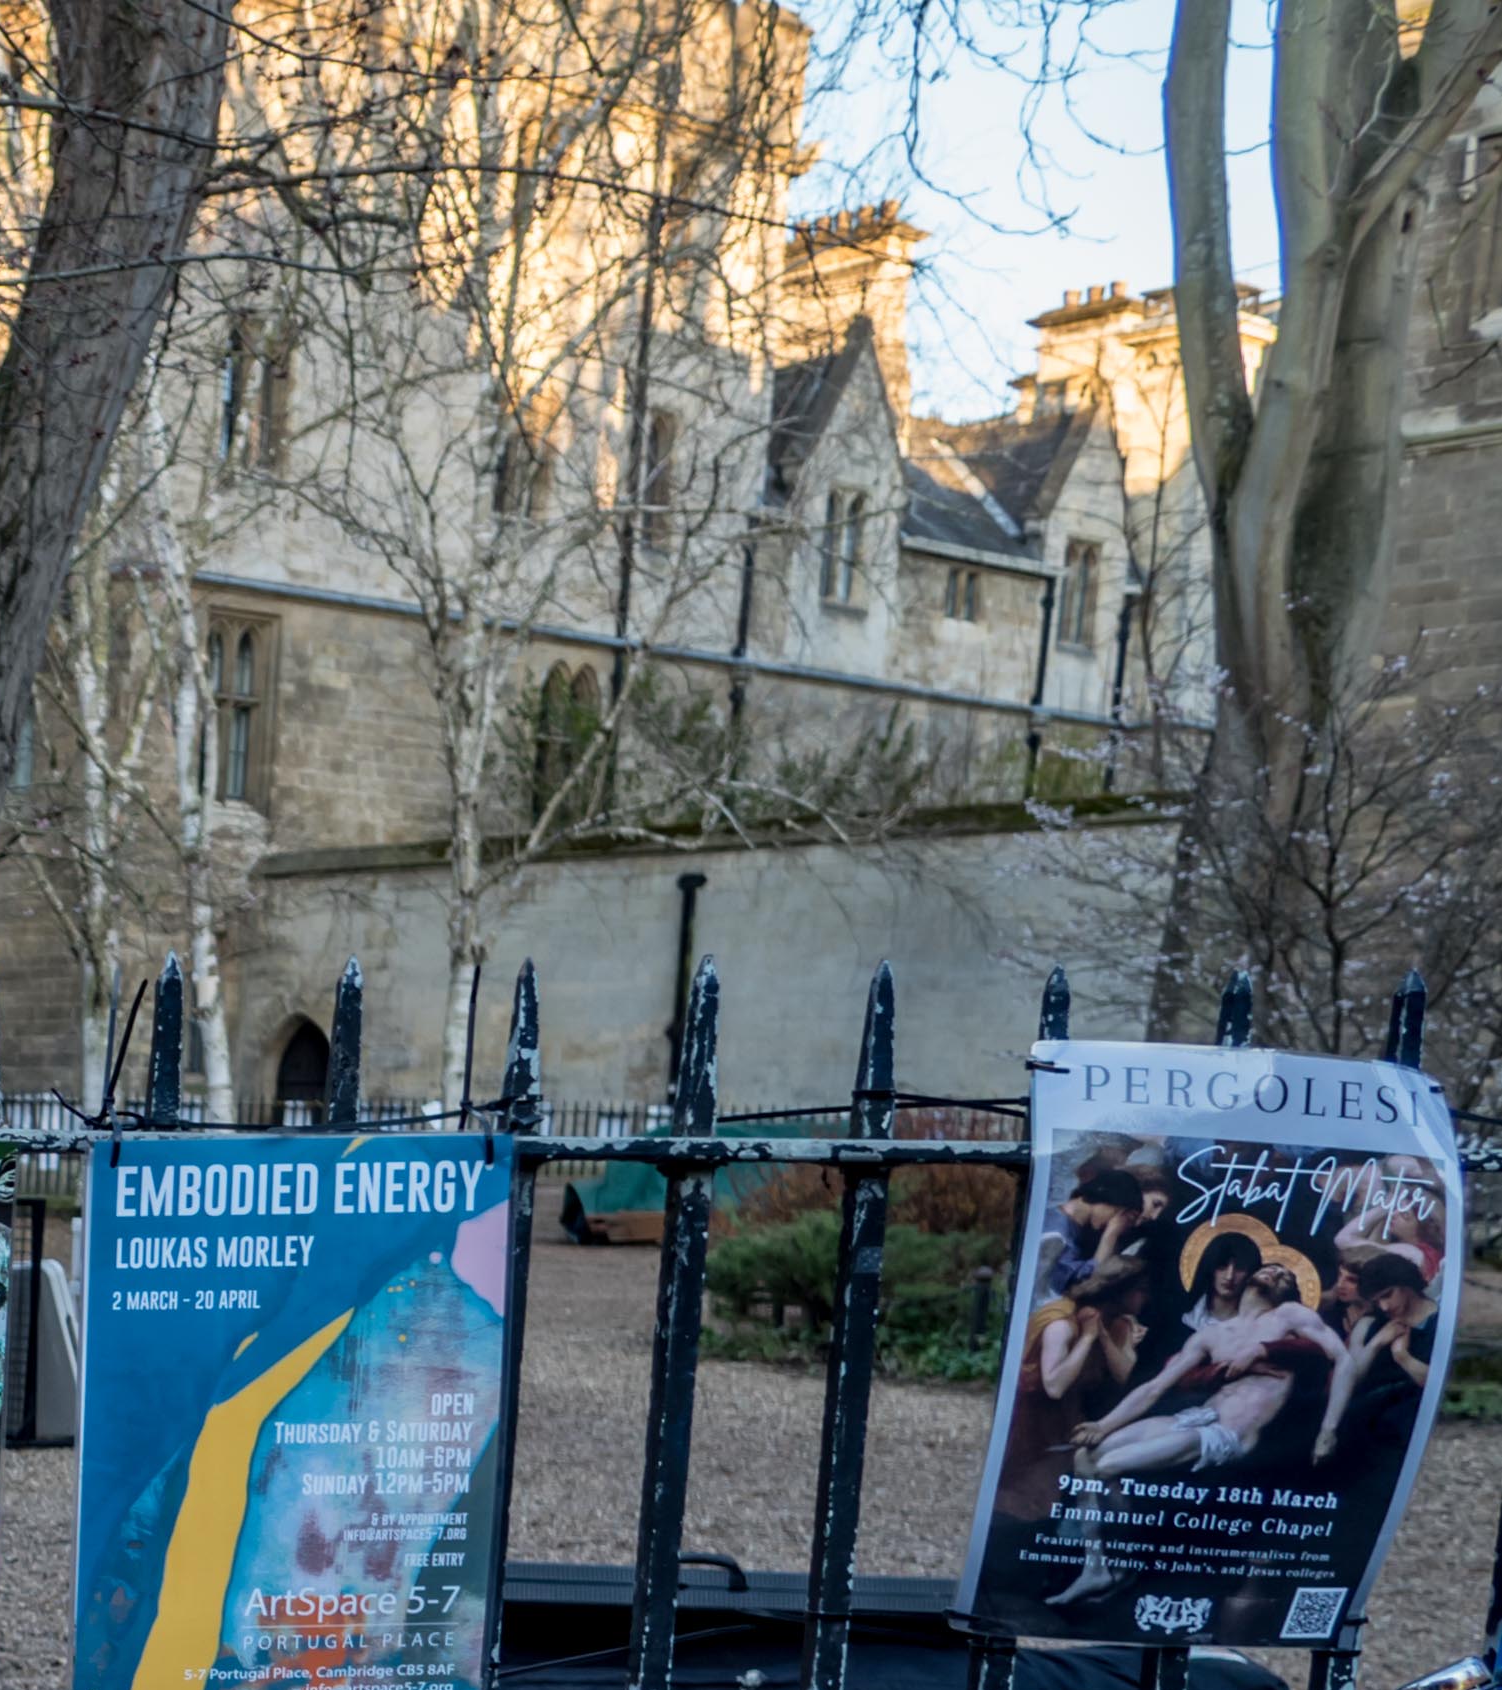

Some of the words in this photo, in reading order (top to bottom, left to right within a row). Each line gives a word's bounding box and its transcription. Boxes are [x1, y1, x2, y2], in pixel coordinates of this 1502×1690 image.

[1082, 1064, 1421, 1128] PERGOLESI
[115, 1162, 318, 1218] EMBODIED
[334, 1158, 485, 1214] ENERGY
[1175, 1145, 1307, 1232] Stabat
[1310, 1156, 1435, 1240] Mater
[115, 1236, 208, 1269] LOUKAS
[216, 1235, 315, 1268] MORLEY
[431, 1393, 474, 1417] OPEN
[1049, 1502, 1165, 1527] Emmanuel
[1173, 1511, 1252, 1535] College
[1261, 1517, 1333, 1538] Chapel
[404, 1553, 428, 1567] FREE
[432, 1553, 464, 1566] ENTRY
[244, 1586, 397, 1622] ArtSpace
[407, 1585, 460, 1615] 5-7
[242, 1633, 368, 1650] PORTUGAL
[382, 1631, 455, 1648] PLACE
